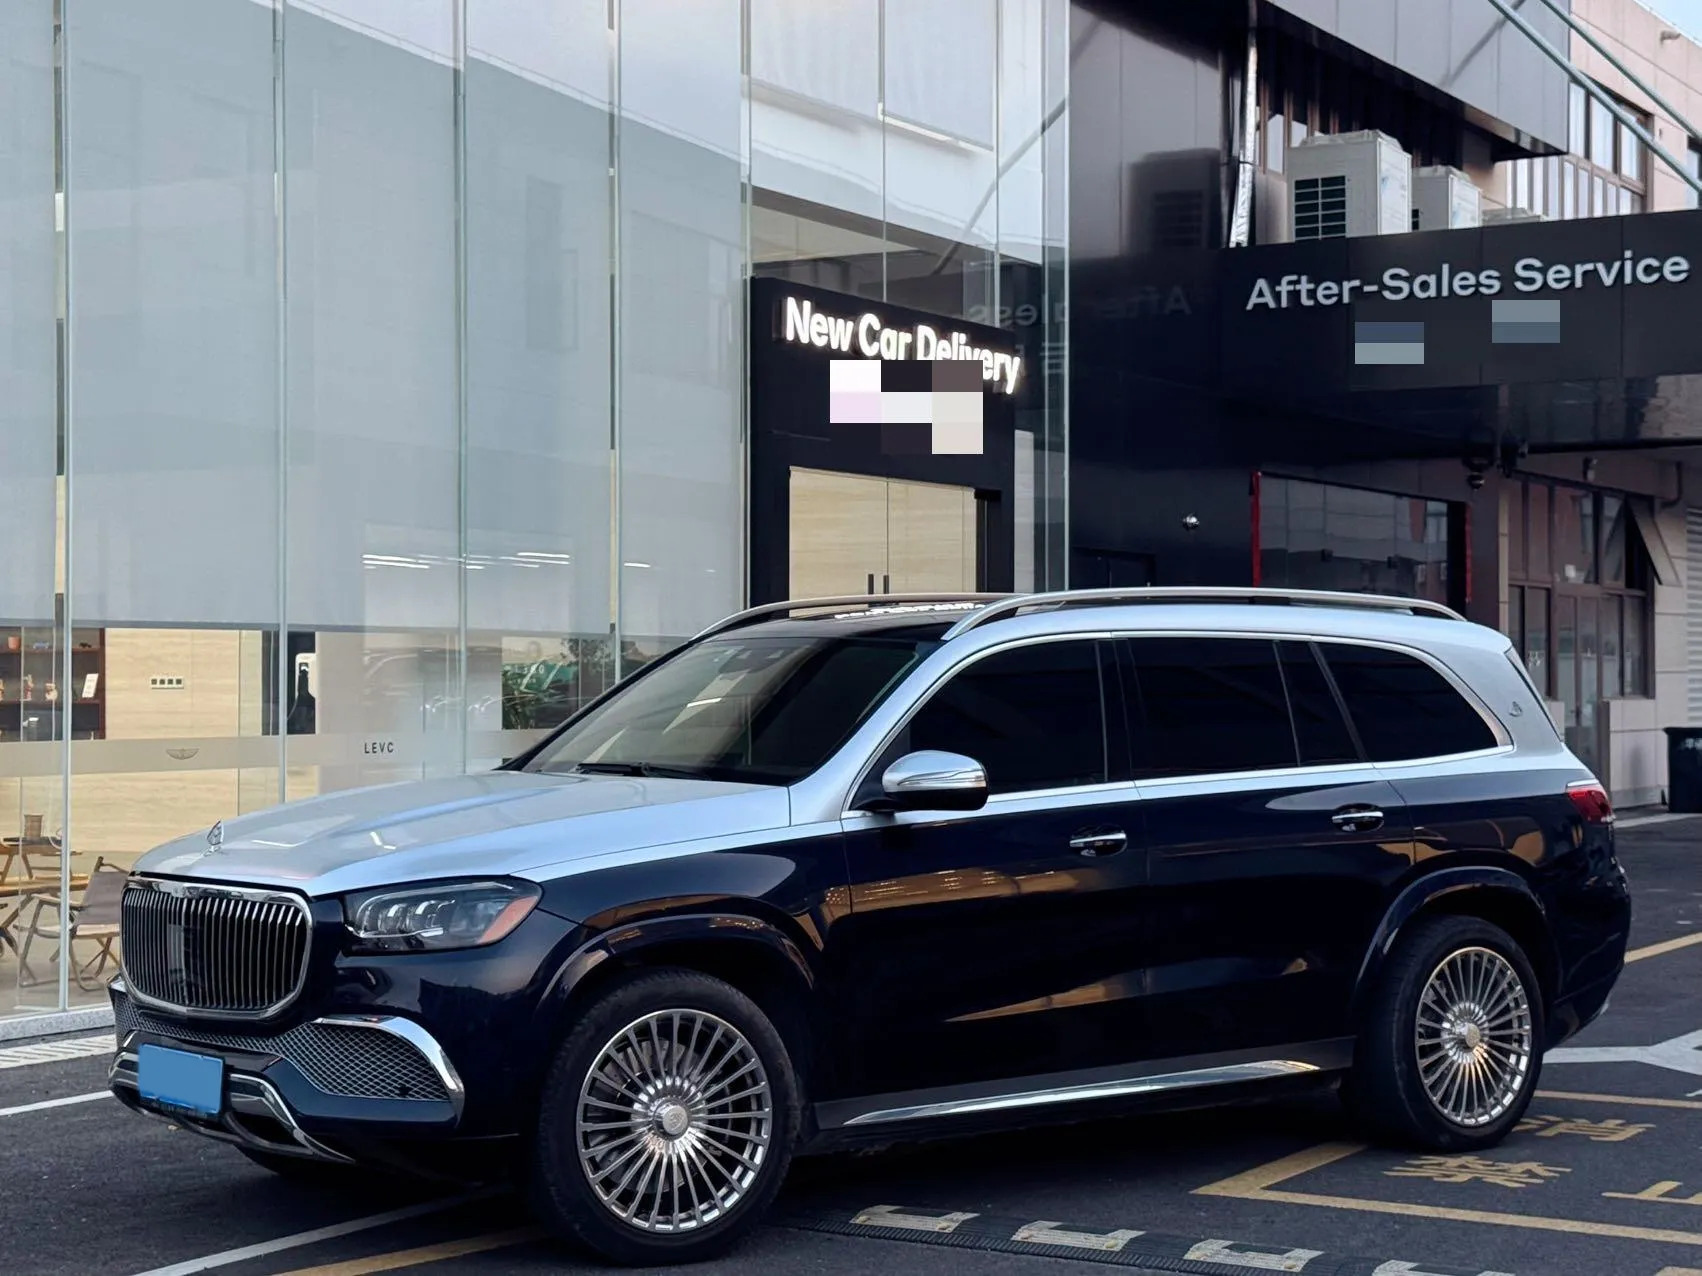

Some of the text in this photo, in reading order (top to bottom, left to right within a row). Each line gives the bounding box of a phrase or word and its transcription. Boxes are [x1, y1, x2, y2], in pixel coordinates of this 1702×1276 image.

[1246, 264, 1501, 311] After-Sales
[1514, 250, 1690, 292] Service
[786, 296, 855, 352] New
[858, 313, 913, 361] Car
[364, 741, 394, 754] LEVC
